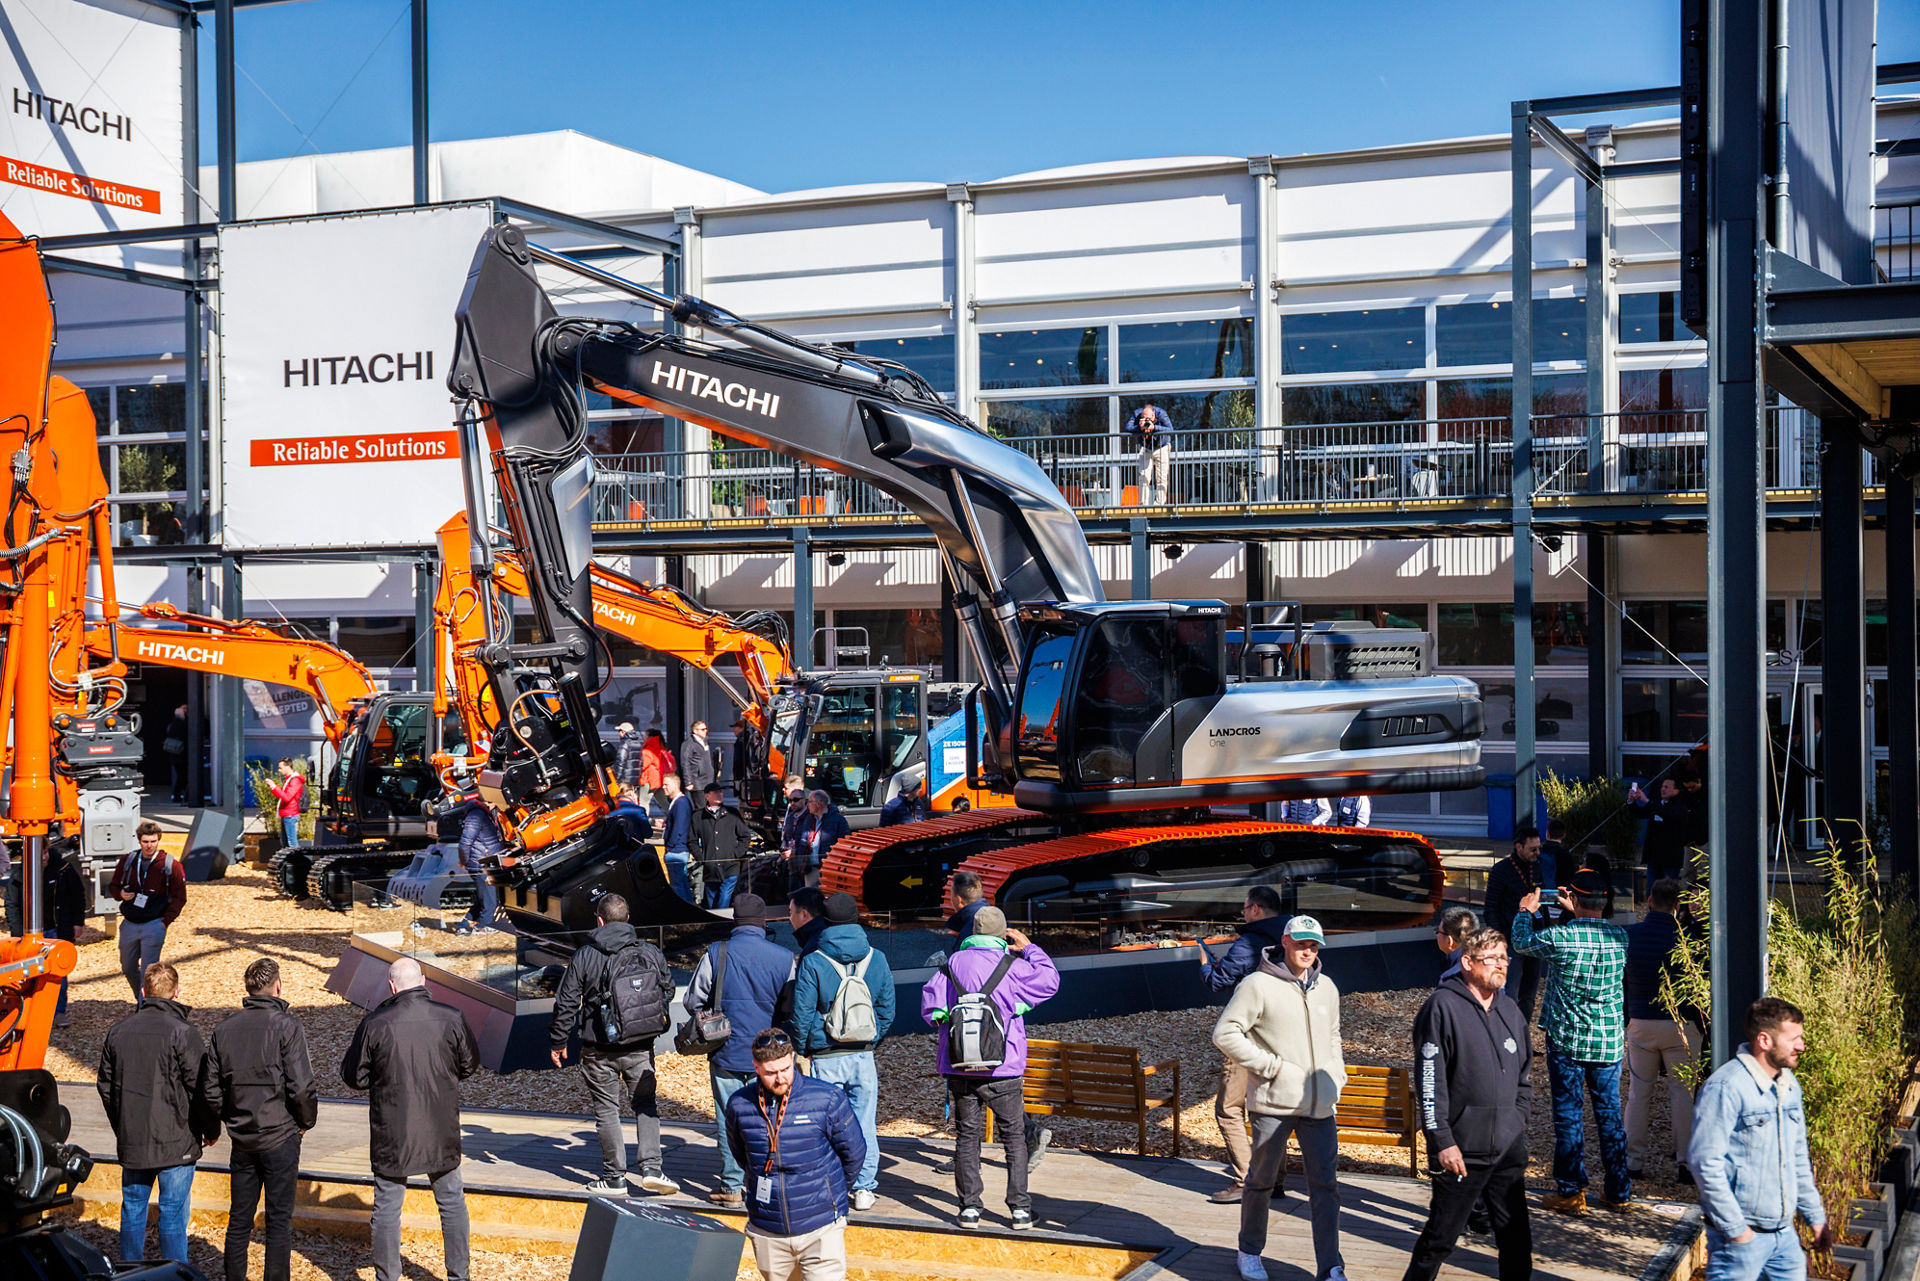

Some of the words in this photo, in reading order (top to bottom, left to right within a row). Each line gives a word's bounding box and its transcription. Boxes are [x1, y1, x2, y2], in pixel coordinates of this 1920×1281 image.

[13, 87, 131, 142] HITACHI
[7, 162, 68, 192] Reliable
[71, 177, 143, 208] Solutions
[283, 351, 434, 388] HITACHI
[651, 360, 780, 418] HITACHI
[272, 440, 349, 462] Reliable
[354, 437, 446, 459] Solutions
[592, 599, 636, 626] TACHI
[138, 641, 224, 665] HITACHI
[1209, 726, 1261, 737] LANDCROS
[1210, 739, 1226, 747] One
[1422, 1060, 1438, 1130] HARLEY-DAVIDSON
